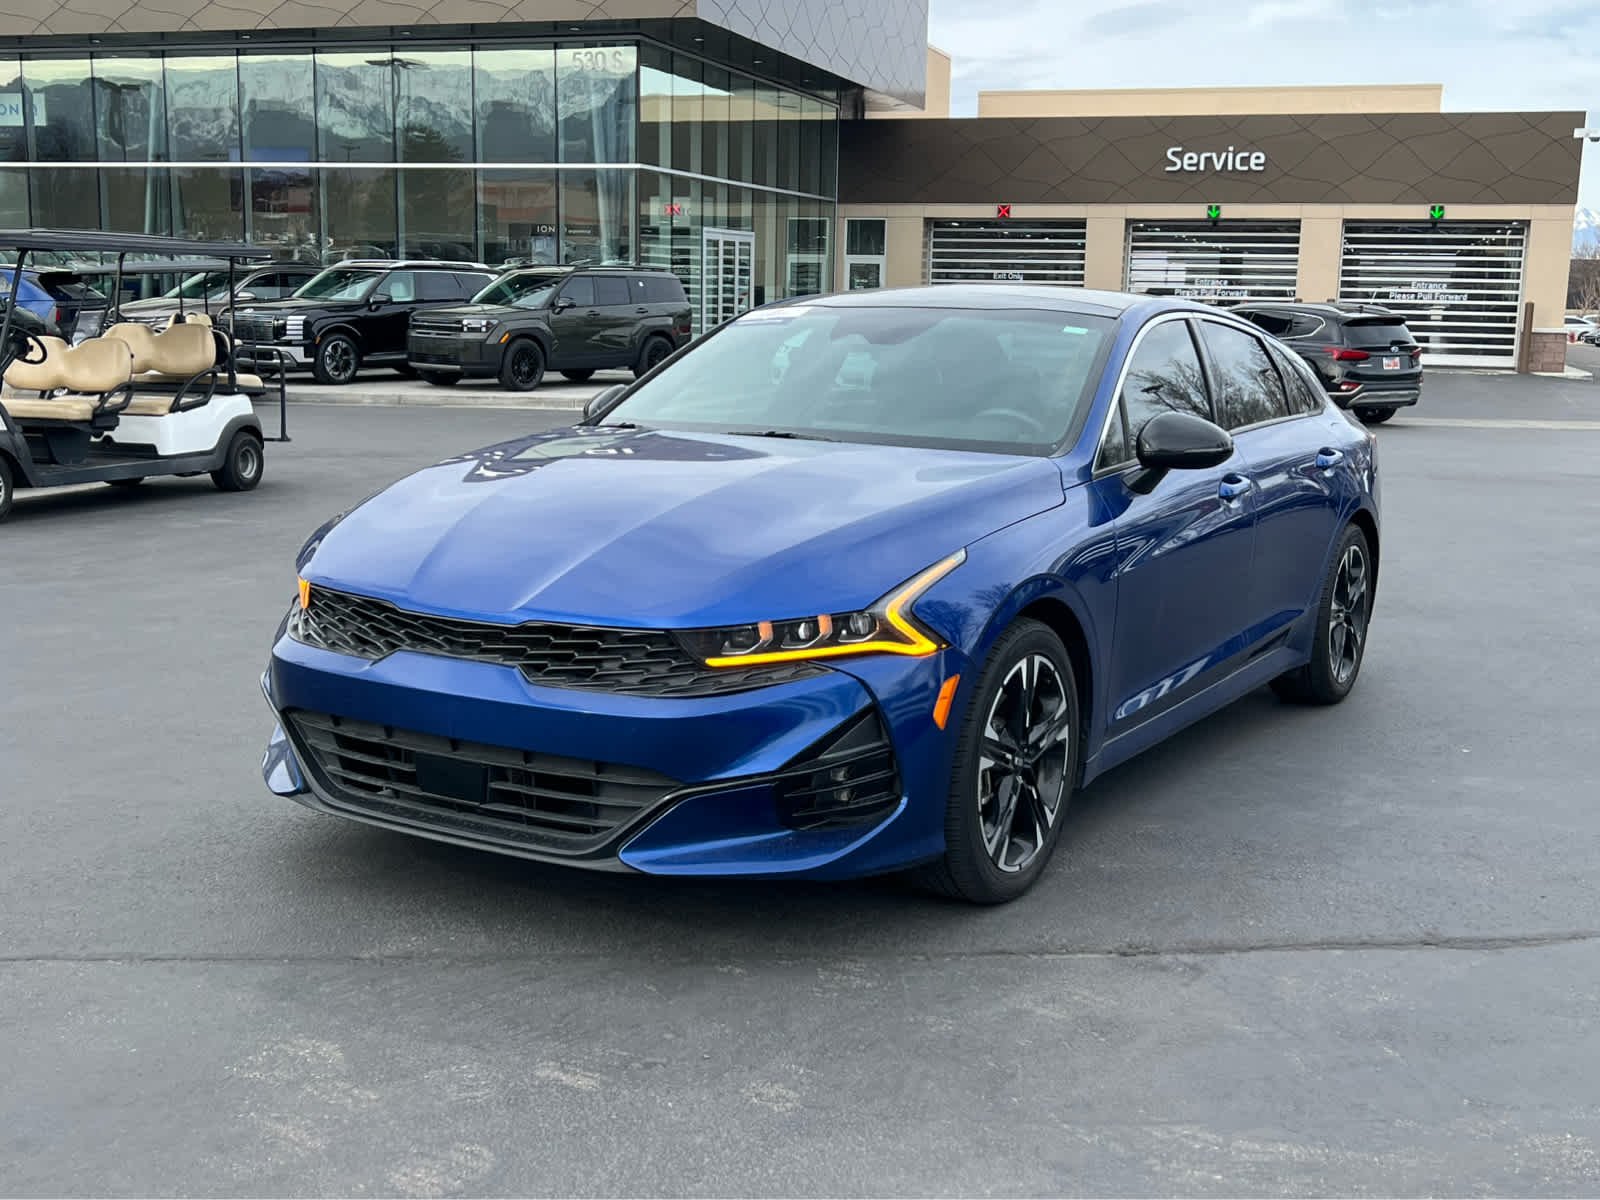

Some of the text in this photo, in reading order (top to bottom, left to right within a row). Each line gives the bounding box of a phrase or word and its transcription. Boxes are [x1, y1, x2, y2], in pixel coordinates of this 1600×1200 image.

[572, 50, 623, 71] 530 S
[1164, 145, 1265, 171] Service
[993, 272, 1024, 282] Exit Only
[1411, 281, 1447, 290] Entrance
[1216, 289, 1248, 297] Forward
[1389, 291, 1468, 301] Please Pull Forward
